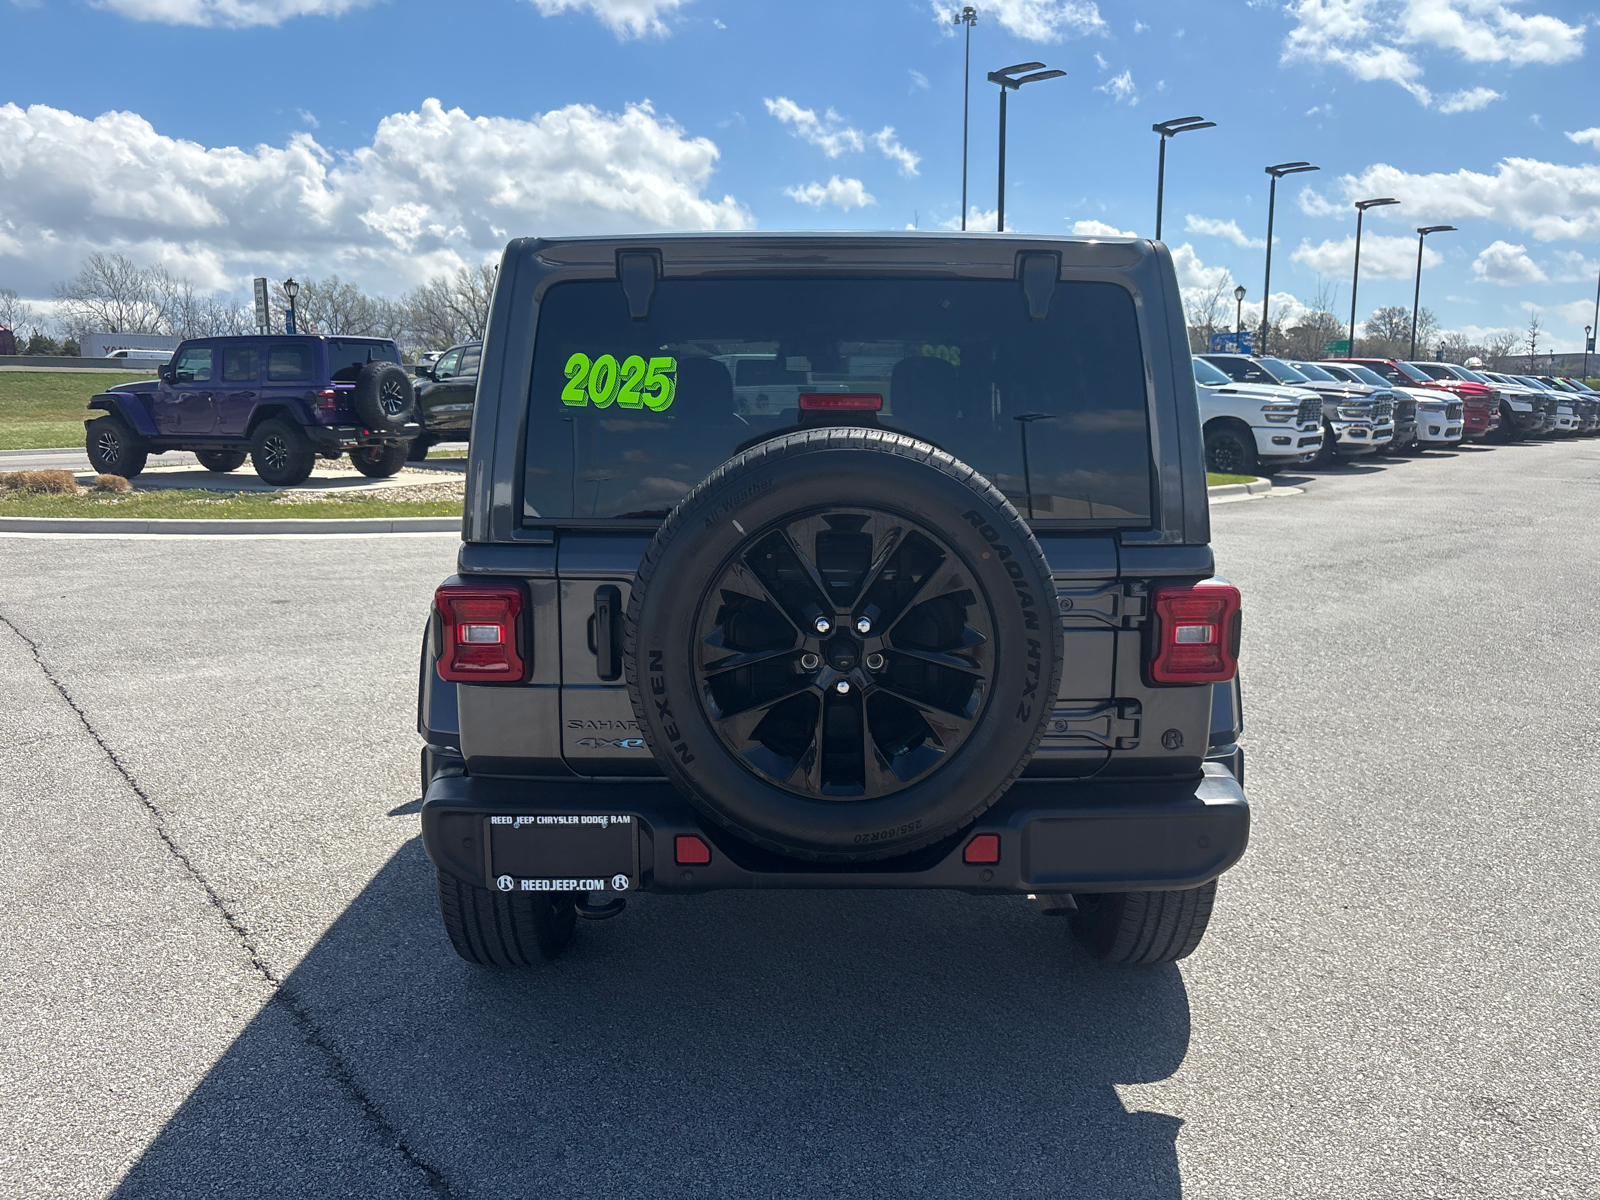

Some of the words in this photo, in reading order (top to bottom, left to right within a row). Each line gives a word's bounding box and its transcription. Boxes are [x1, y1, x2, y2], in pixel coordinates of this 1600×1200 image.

[561, 352, 678, 412] 2025
[705, 479, 772, 530] All-Weather
[961, 509, 1040, 631] ROADIAN
[1022, 638, 1042, 700] HTX
[567, 720, 640, 730] SAHAR
[649, 650, 695, 765] NEXEN
[1015, 700, 1031, 724] 2
[491, 816, 513, 825] REED
[516, 816, 534, 824] JEEP
[536, 816, 579, 824] CHRYSLER
[581, 815, 609, 825] DODGE
[611, 815, 631, 824] RAM
[854, 818, 922, 843] 255/60R20
[521, 879, 605, 891] REEDJEEP.COM
